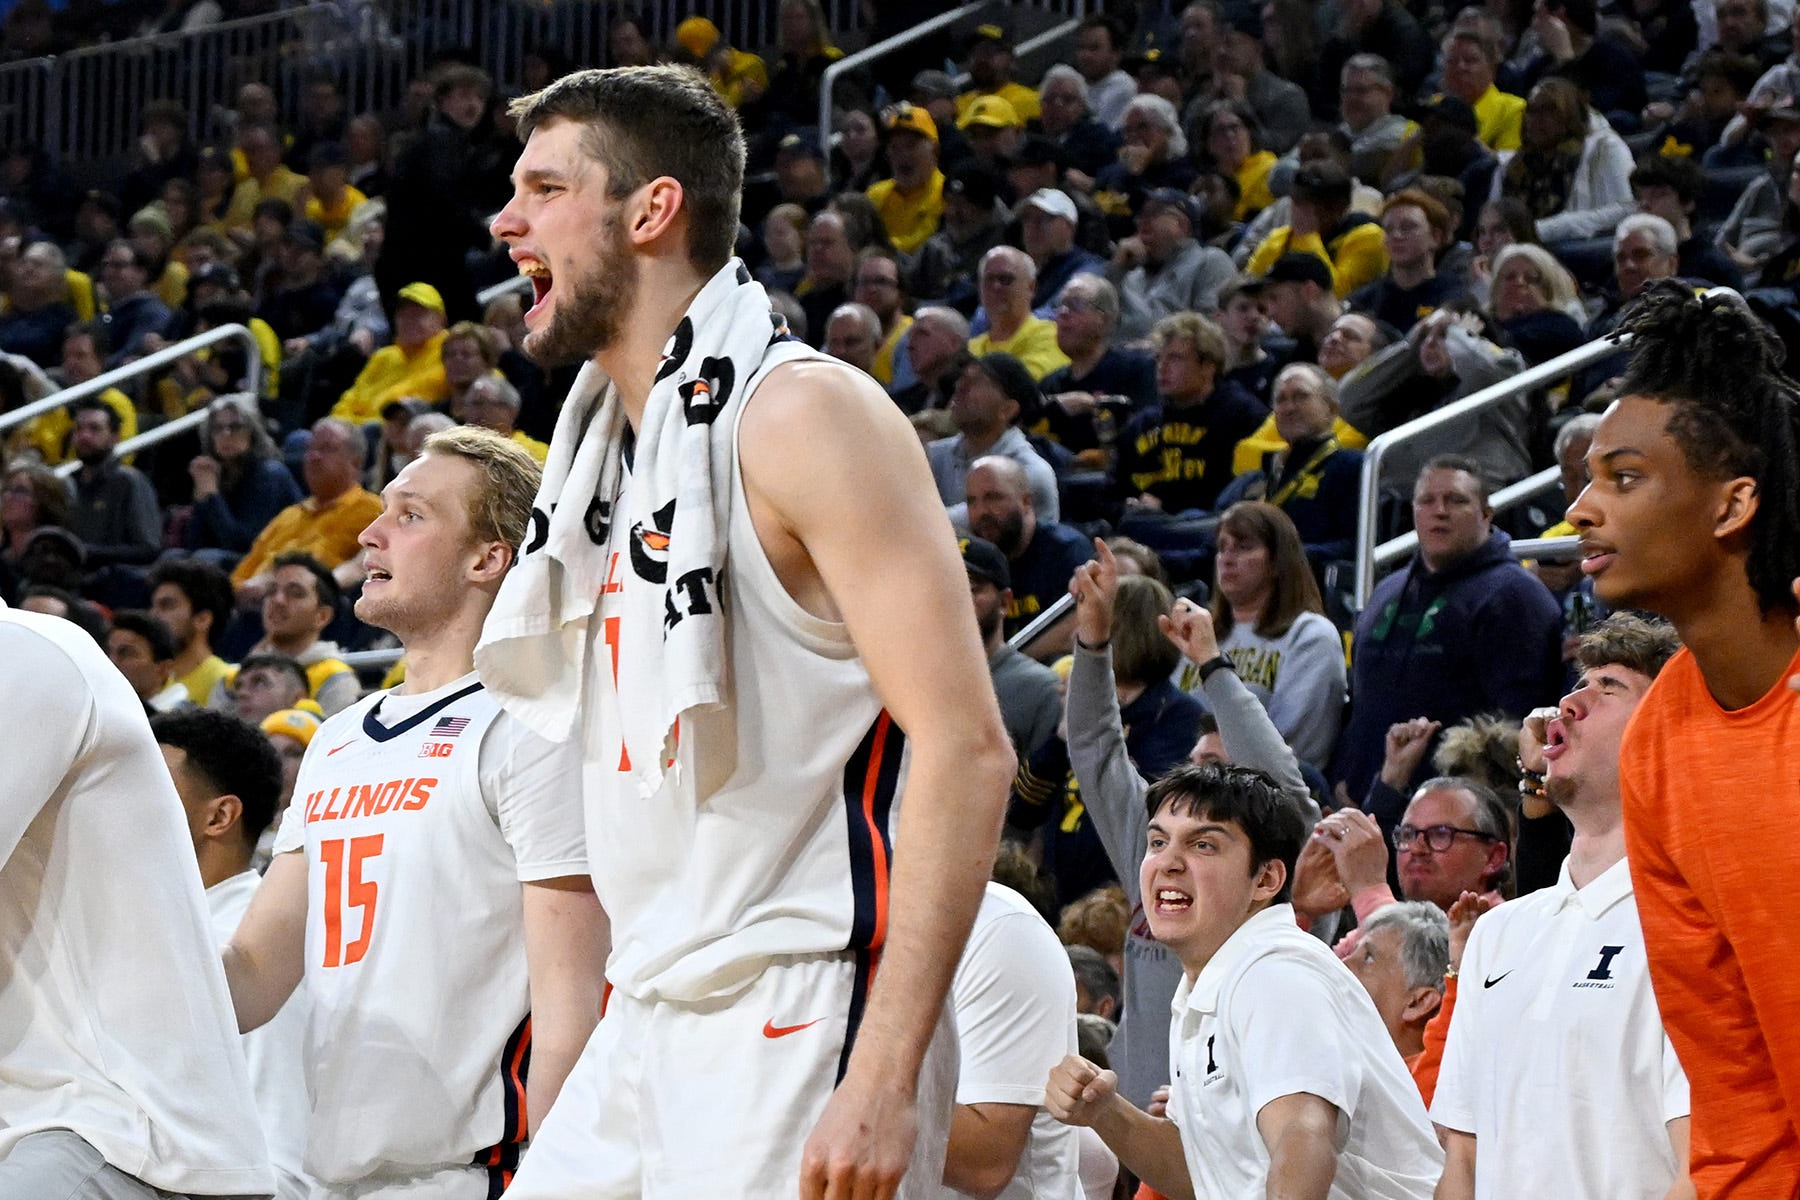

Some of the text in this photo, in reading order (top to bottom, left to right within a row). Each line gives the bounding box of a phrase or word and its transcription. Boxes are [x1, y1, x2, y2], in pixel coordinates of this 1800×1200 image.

[304, 778, 439, 828] ILLINOIS
[320, 833, 384, 968] 15
[1586, 945, 1626, 980] I
